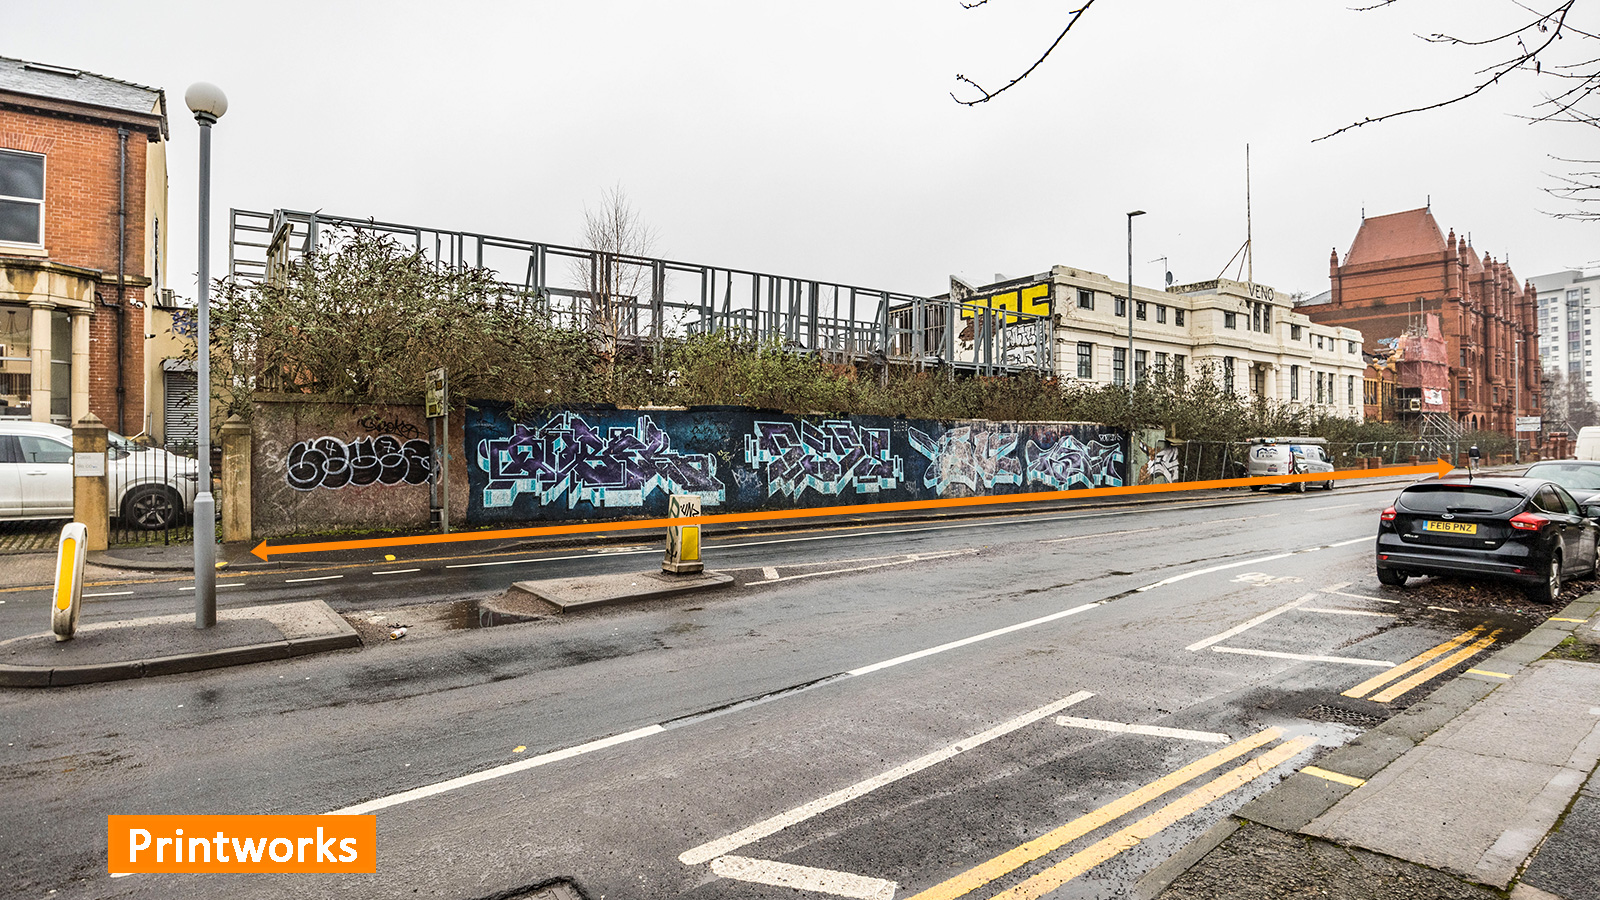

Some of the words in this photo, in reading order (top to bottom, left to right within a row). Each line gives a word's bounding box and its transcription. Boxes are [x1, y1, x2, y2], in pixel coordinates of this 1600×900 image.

[1247, 283, 1274, 301] VENO
[1430, 522, 1451, 531] FE16
[1453, 523, 1473, 532] PNZ
